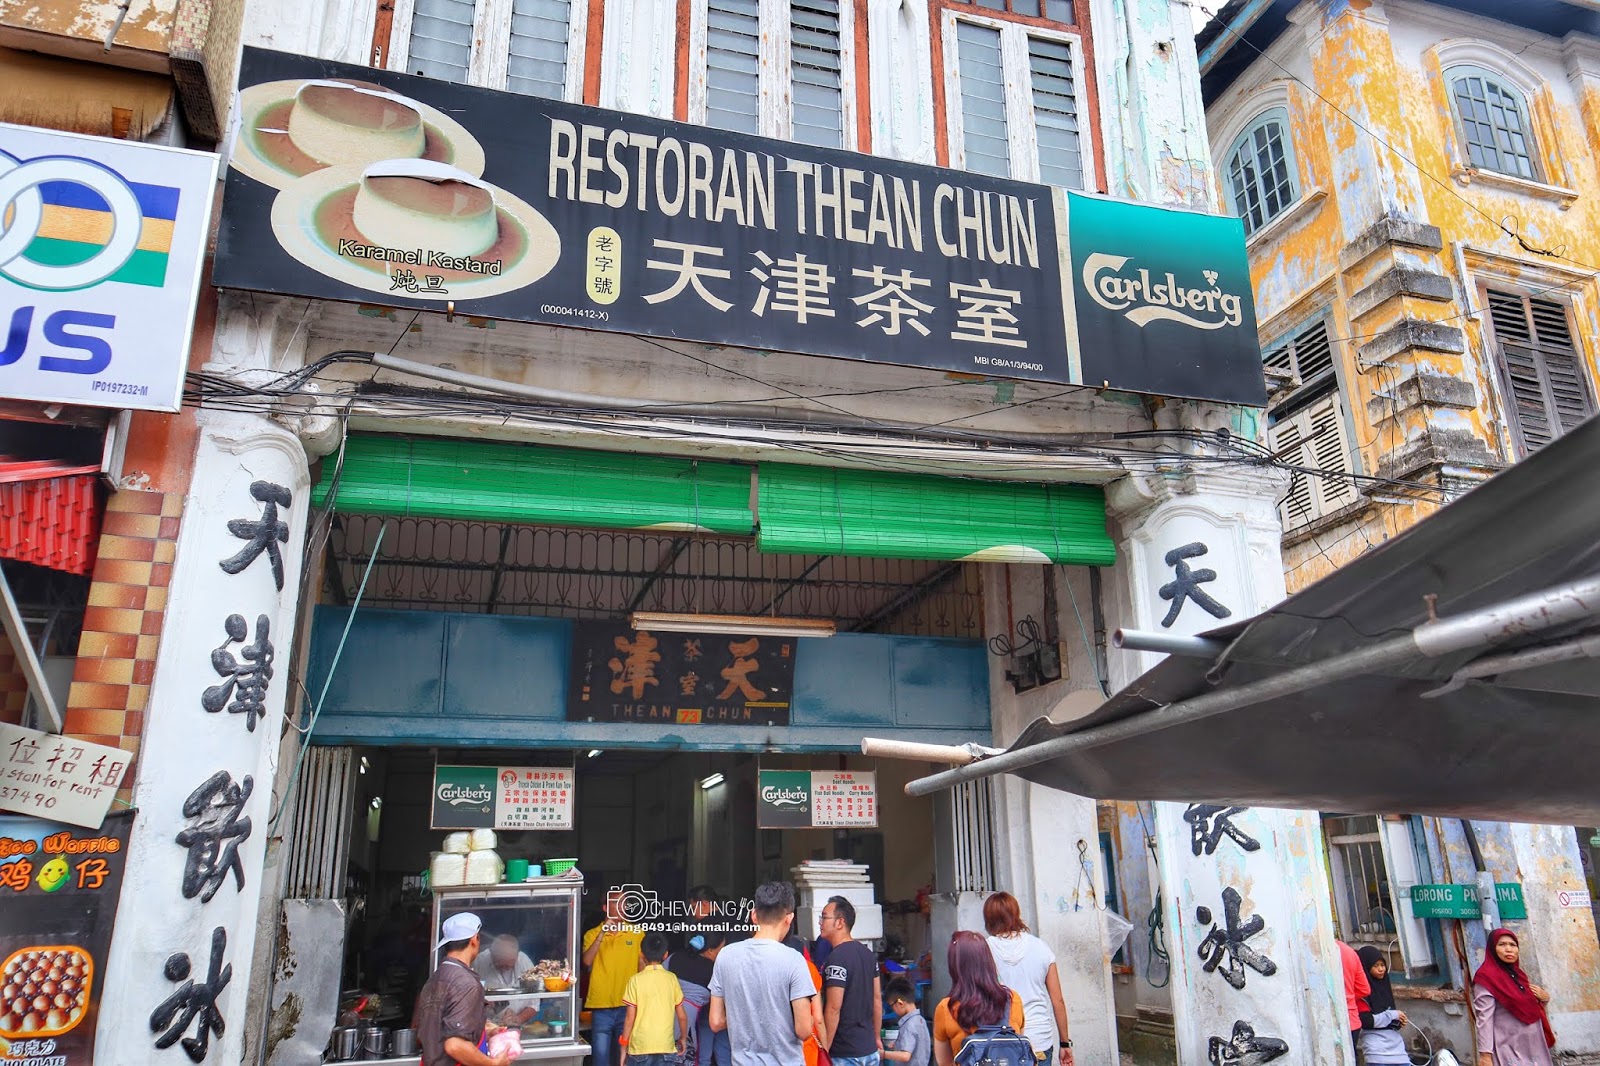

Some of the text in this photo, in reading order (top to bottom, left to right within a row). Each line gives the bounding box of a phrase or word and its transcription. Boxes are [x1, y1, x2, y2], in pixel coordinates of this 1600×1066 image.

[549, 118, 1041, 269] RESTORAN THEAN CHUN
[338, 239, 502, 276] Karamel Kastard
[594, 234, 614, 296] 老字號
[641, 238, 1029, 349] 天津茶室
[1082, 252, 1243, 329] Carlsberg
[540, 303, 610, 322] (000041412-X)
[974, 355, 990, 366] MBI
[612, 703, 751, 720] THEAN CHUN
[680, 709, 699, 723] 73
[43, 773, 67, 790] for
[70, 782, 103, 800] rent
[437, 783, 492, 806] Carlsberg
[761, 785, 808, 806] Carlsberg
[1413, 887, 1453, 903] LORONG
[1460, 907, 1480, 915] 30000
[8, 1038, 57, 1056] 巧克力
